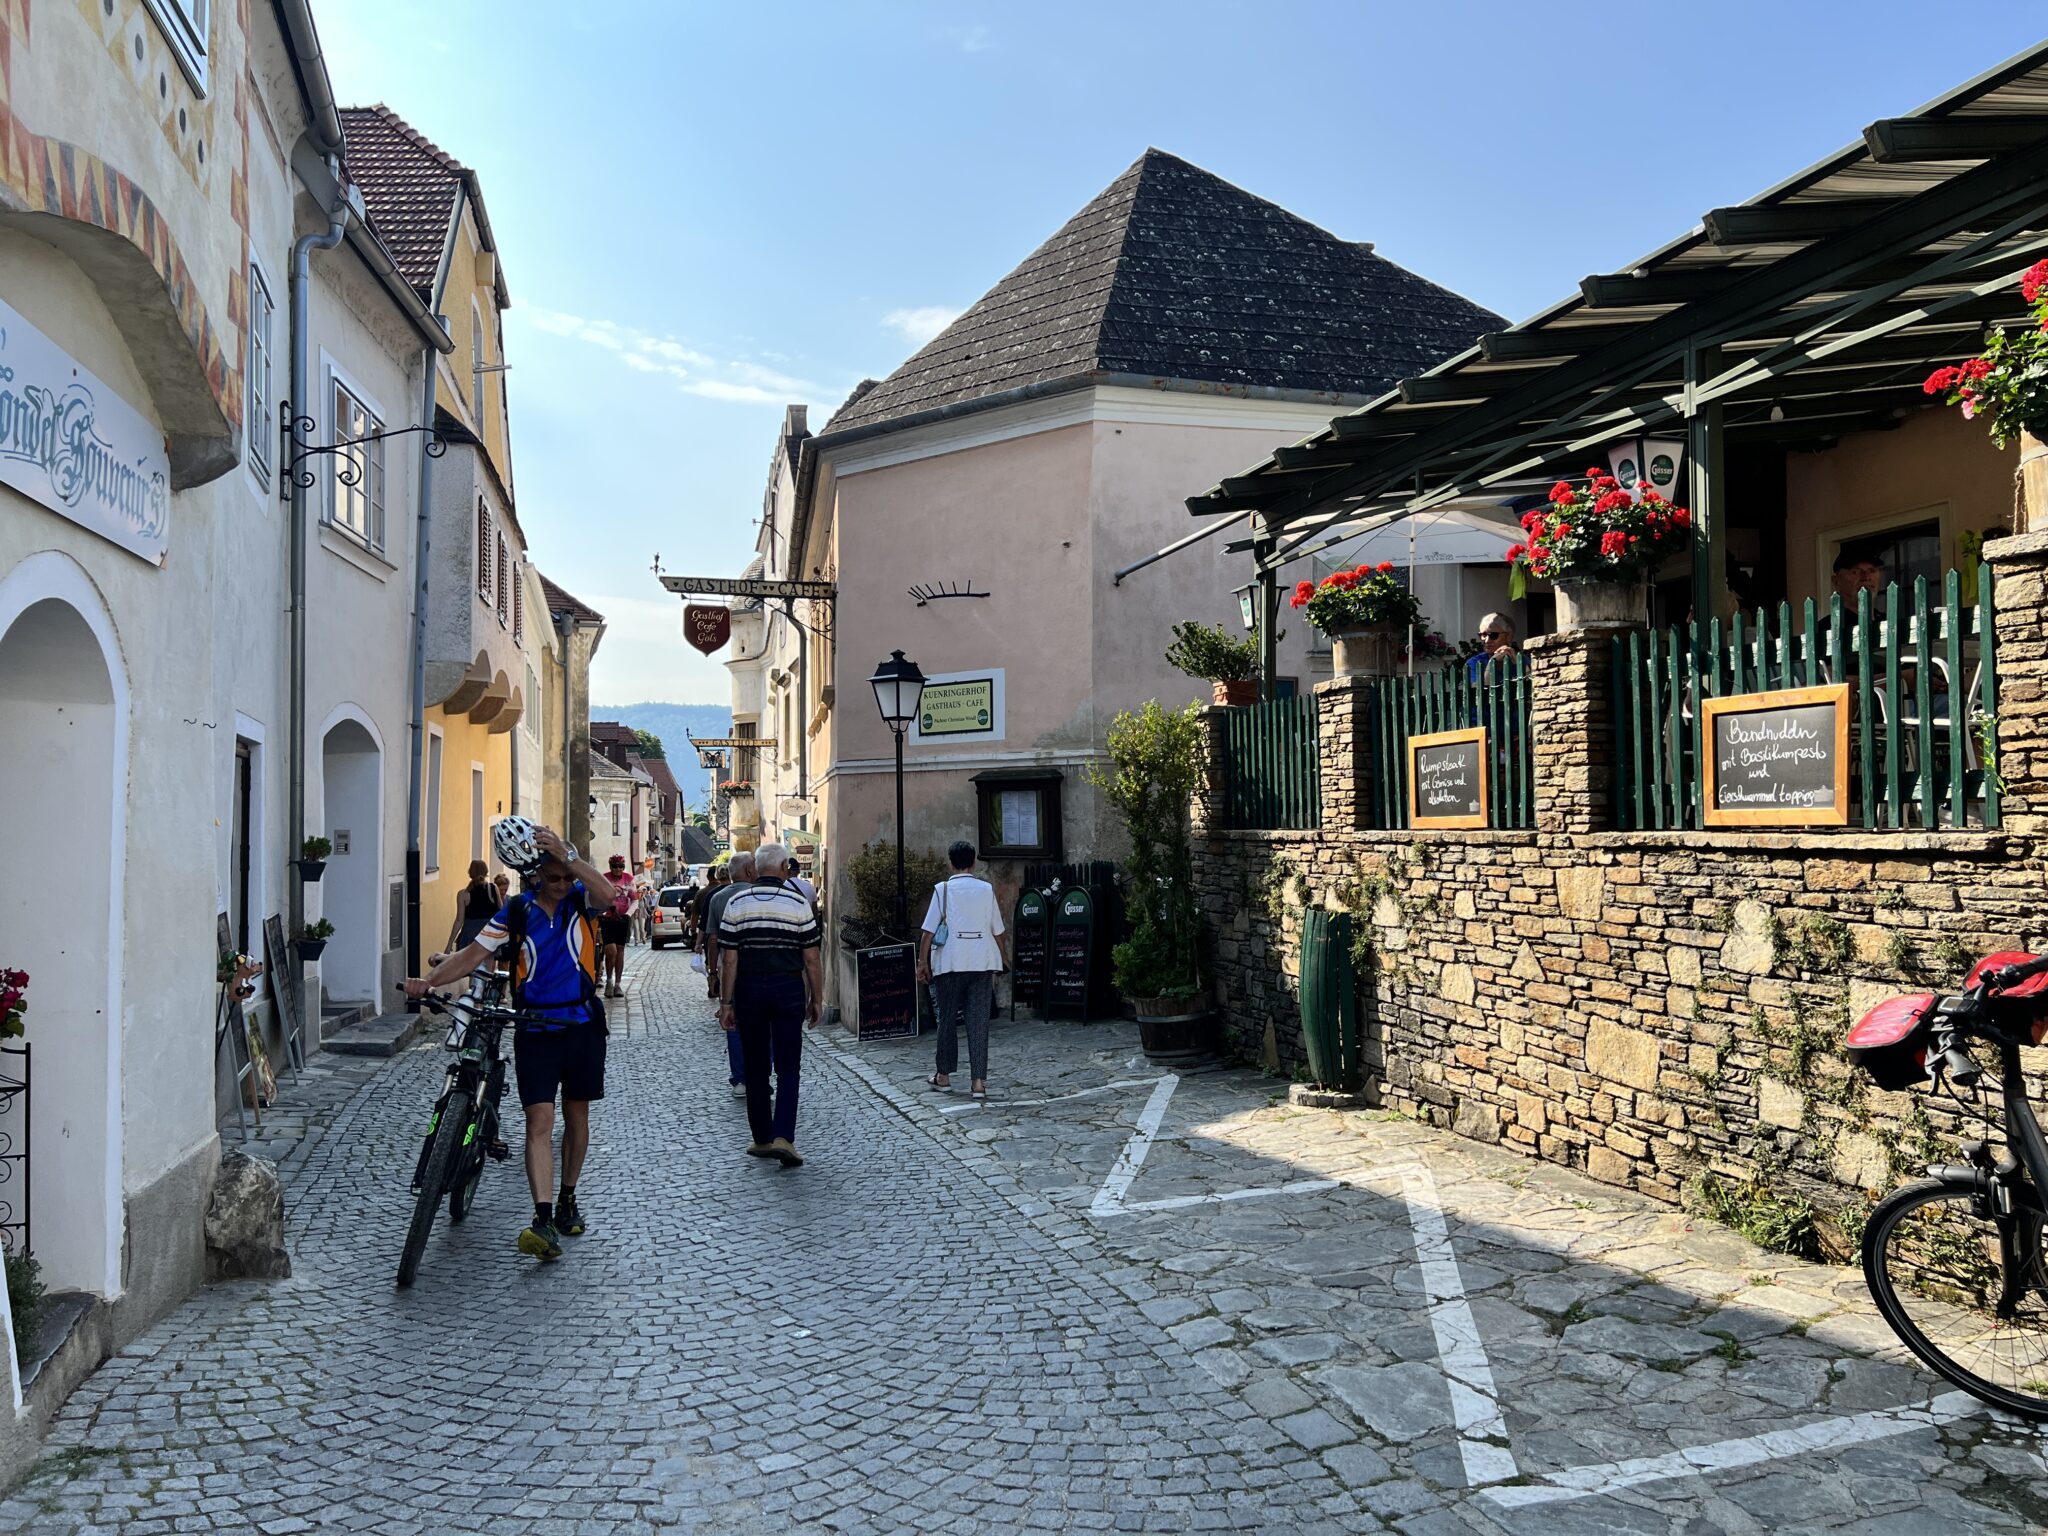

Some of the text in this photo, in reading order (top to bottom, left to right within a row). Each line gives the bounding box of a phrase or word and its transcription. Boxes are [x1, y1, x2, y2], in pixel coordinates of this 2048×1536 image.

[683, 579, 821, 596] GASTHOF CAFE
[691, 610, 726, 623] Gasthof
[697, 621, 716, 632] Cafe
[923, 686, 987, 700] KUENRINGERHOF
[926, 699, 984, 711] GASTHAUS CAFE
[712, 739, 758, 747] GASTHOF
[1722, 740, 1827, 771] mit Basilikumpesto
[1421, 753, 1467, 776] Rumpsteak
[1748, 763, 1771, 780] und
[1421, 775, 1431, 791] mit
[1454, 772, 1467, 786] und
[1778, 784, 1815, 807] topping
